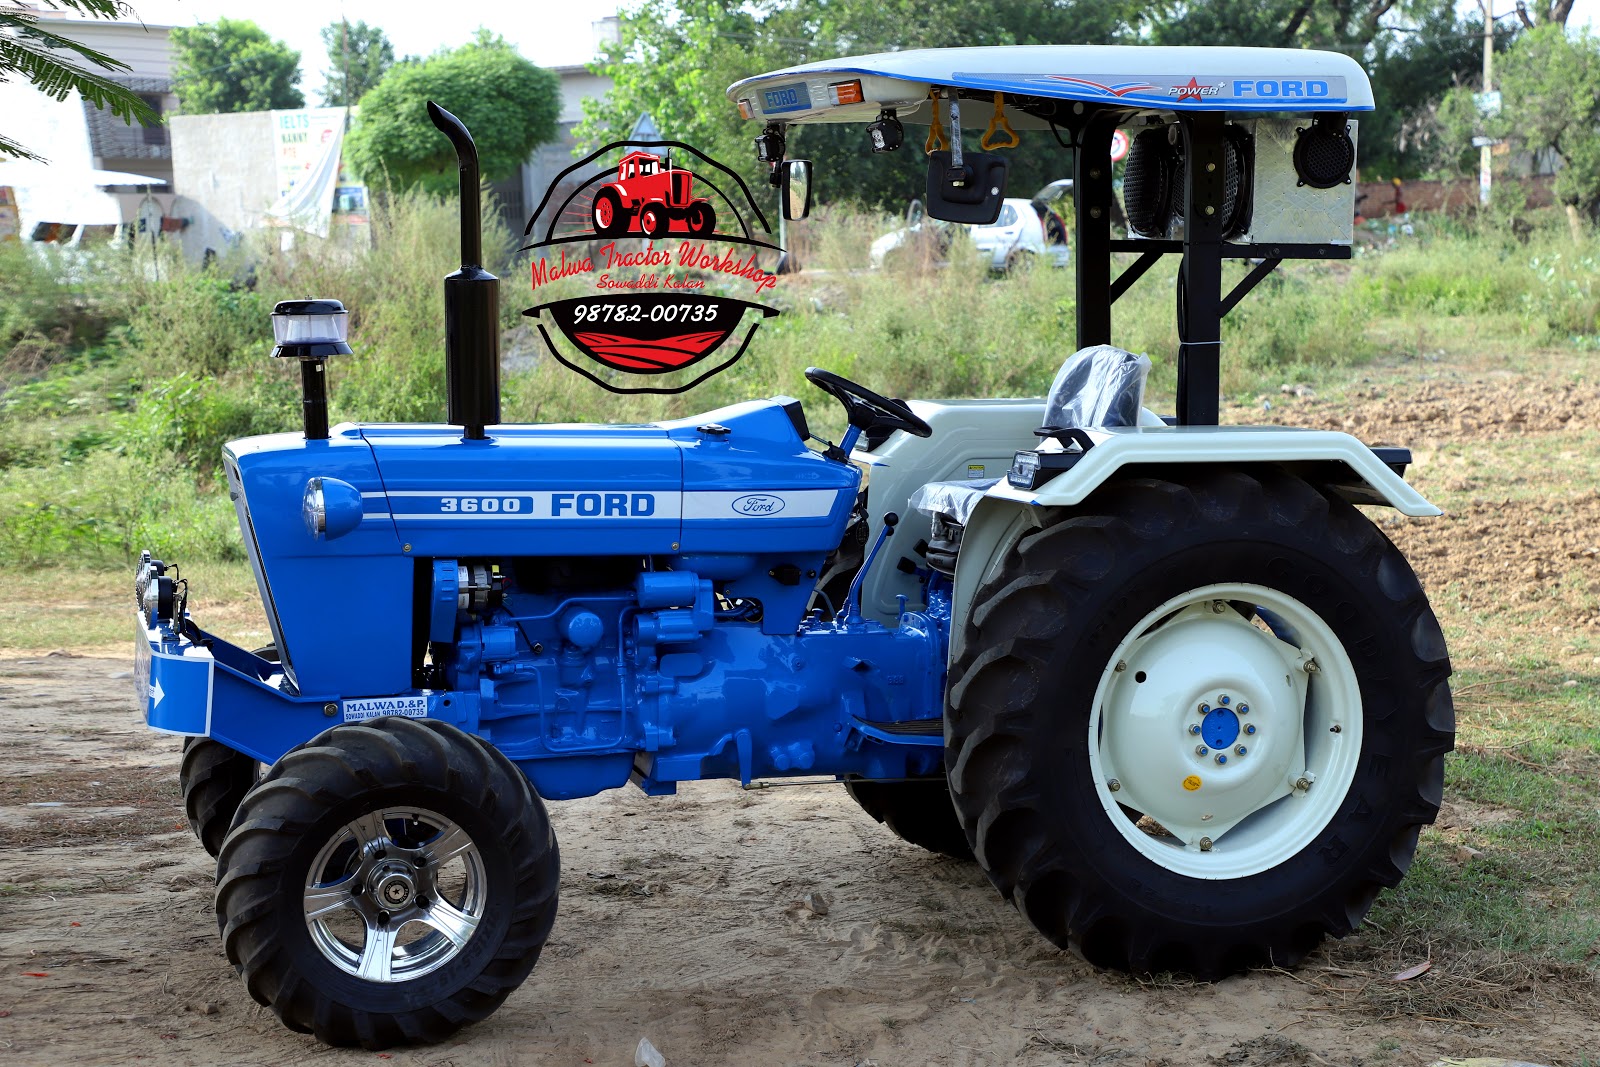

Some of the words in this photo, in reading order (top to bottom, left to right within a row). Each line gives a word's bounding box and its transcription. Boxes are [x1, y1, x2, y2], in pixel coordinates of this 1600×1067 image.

[1232, 80, 1329, 97] FORD
[764, 88, 798, 108] FORD
[279, 113, 310, 129] IELTS
[440, 498, 521, 513] 3600
[550, 493, 655, 517] FORD
[742, 495, 776, 513] Ford
[346, 701, 396, 713] MALWA
